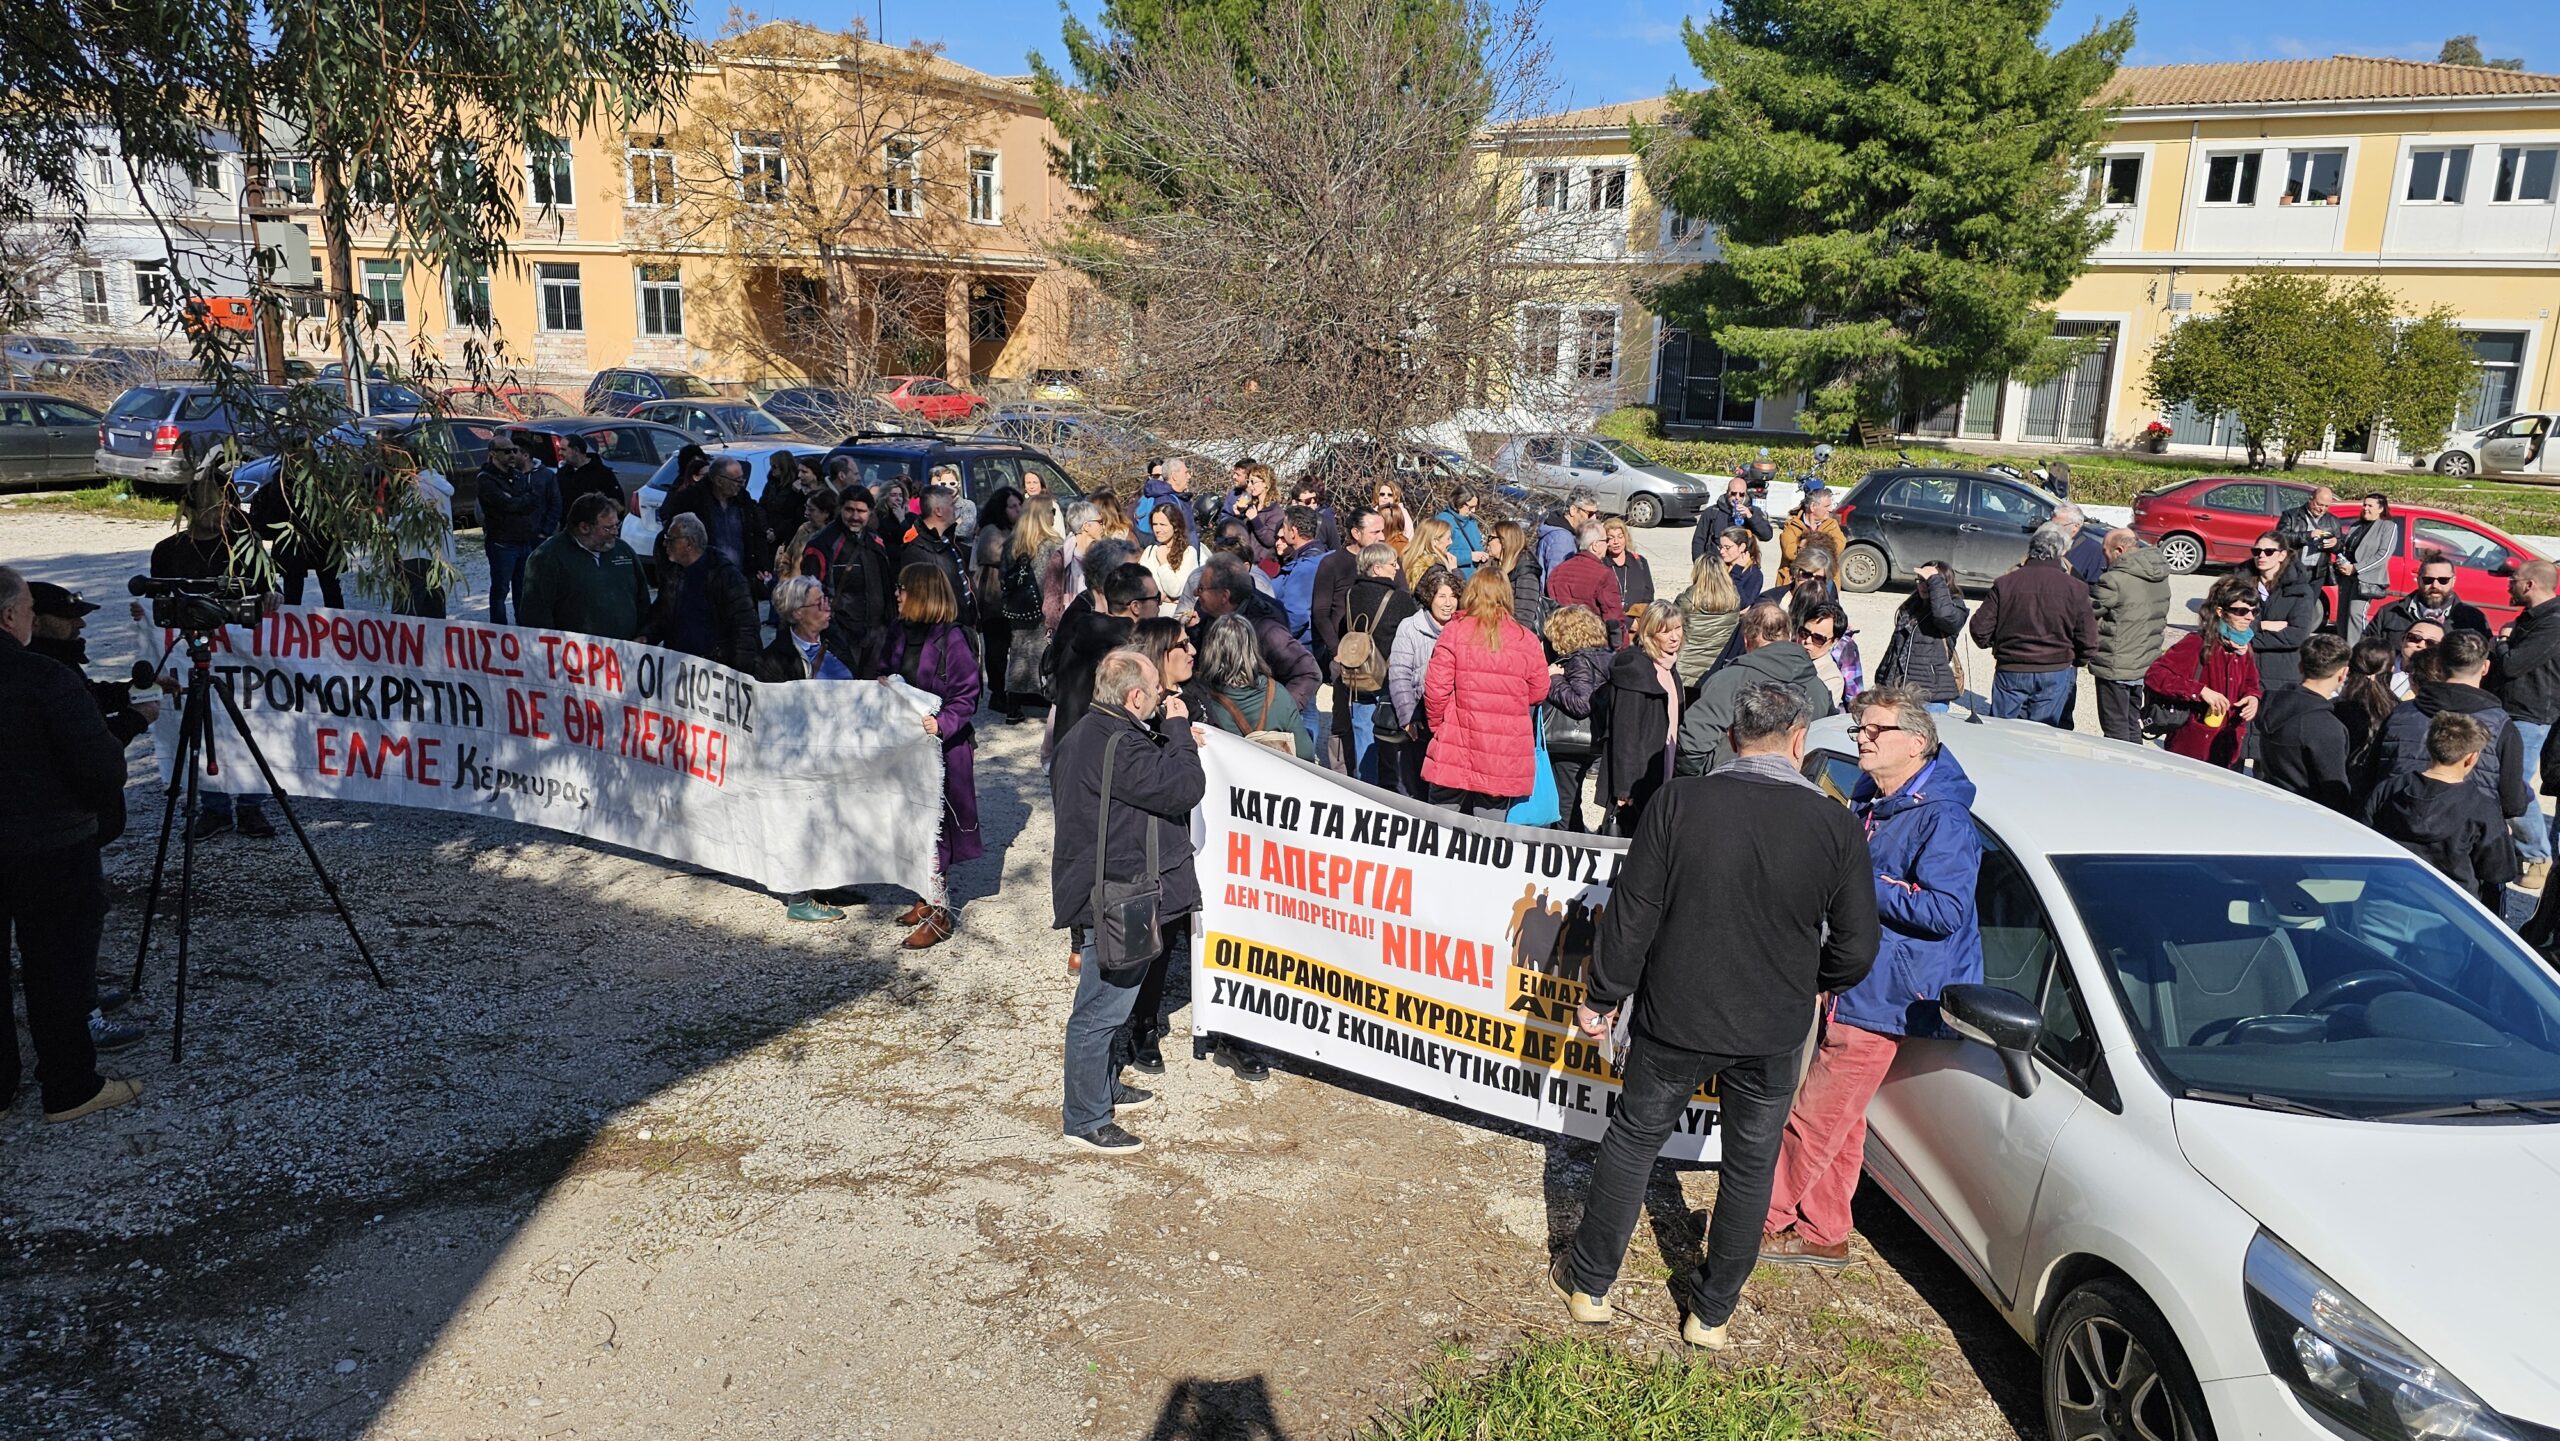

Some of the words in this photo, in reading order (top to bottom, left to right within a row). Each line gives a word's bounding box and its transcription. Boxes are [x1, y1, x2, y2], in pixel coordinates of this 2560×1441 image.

[252, 610, 426, 667] ΠΑΡΘΟΥΝ
[445, 626, 524, 678] ΠΙΣΩ
[538, 635, 623, 694] ΤΩΡΑ
[636, 652, 665, 700] ΟΙ
[674, 661, 754, 733] ΔΙΩΞΕΙΣ
[214, 665, 484, 728] ΤΡΟΜΟΚΡΑΤΙΑ
[507, 688, 550, 740] ΔΕ
[563, 694, 603, 751] ΘΑ
[620, 705, 728, 787] ΠΕΡΑΣΕΙ
[316, 728, 441, 786] ΕΛΜΕ
[1227, 831, 1251, 877] Η
[1260, 840, 1413, 916] ΑΠΕΡΓΙΑ
[1229, 786, 1300, 832] ΚΑΤΩ
[1310, 800, 1344, 839] ΤΑ
[1350, 809, 1439, 856] ΧΕΡΙΑ
[1444, 828, 1513, 869] ΑΠΟ
[1522, 840, 1601, 886] ΤΟΥΣ
[1224, 884, 1260, 912] ΔΕΝ
[1264, 892, 1375, 940] ΤΙΜΩΡΕΙΤΑΙ!
[1382, 922, 1494, 989] ΝΙΚΑ!
[1215, 939, 1241, 970] ΟΙ
[1246, 944, 1390, 1014] ΠΑΡΑΝΟΜΕΣ
[1396, 992, 1517, 1053] ΚΥΡΩΣΕΙΣ
[1521, 1030, 1556, 1063] ΔΕ
[1564, 1041, 1601, 1075] ΘΑ
[1519, 973, 1588, 1006] ΕΙΜΑΣ
[1211, 976, 1332, 1034] ΣΥΛΛΟΓΟΣ
[1337, 1011, 1541, 1100] ΕΚΠΑΙΔΕΥΤΙΚΩΝ
[1548, 1078, 1597, 1117] Π.Ε.
